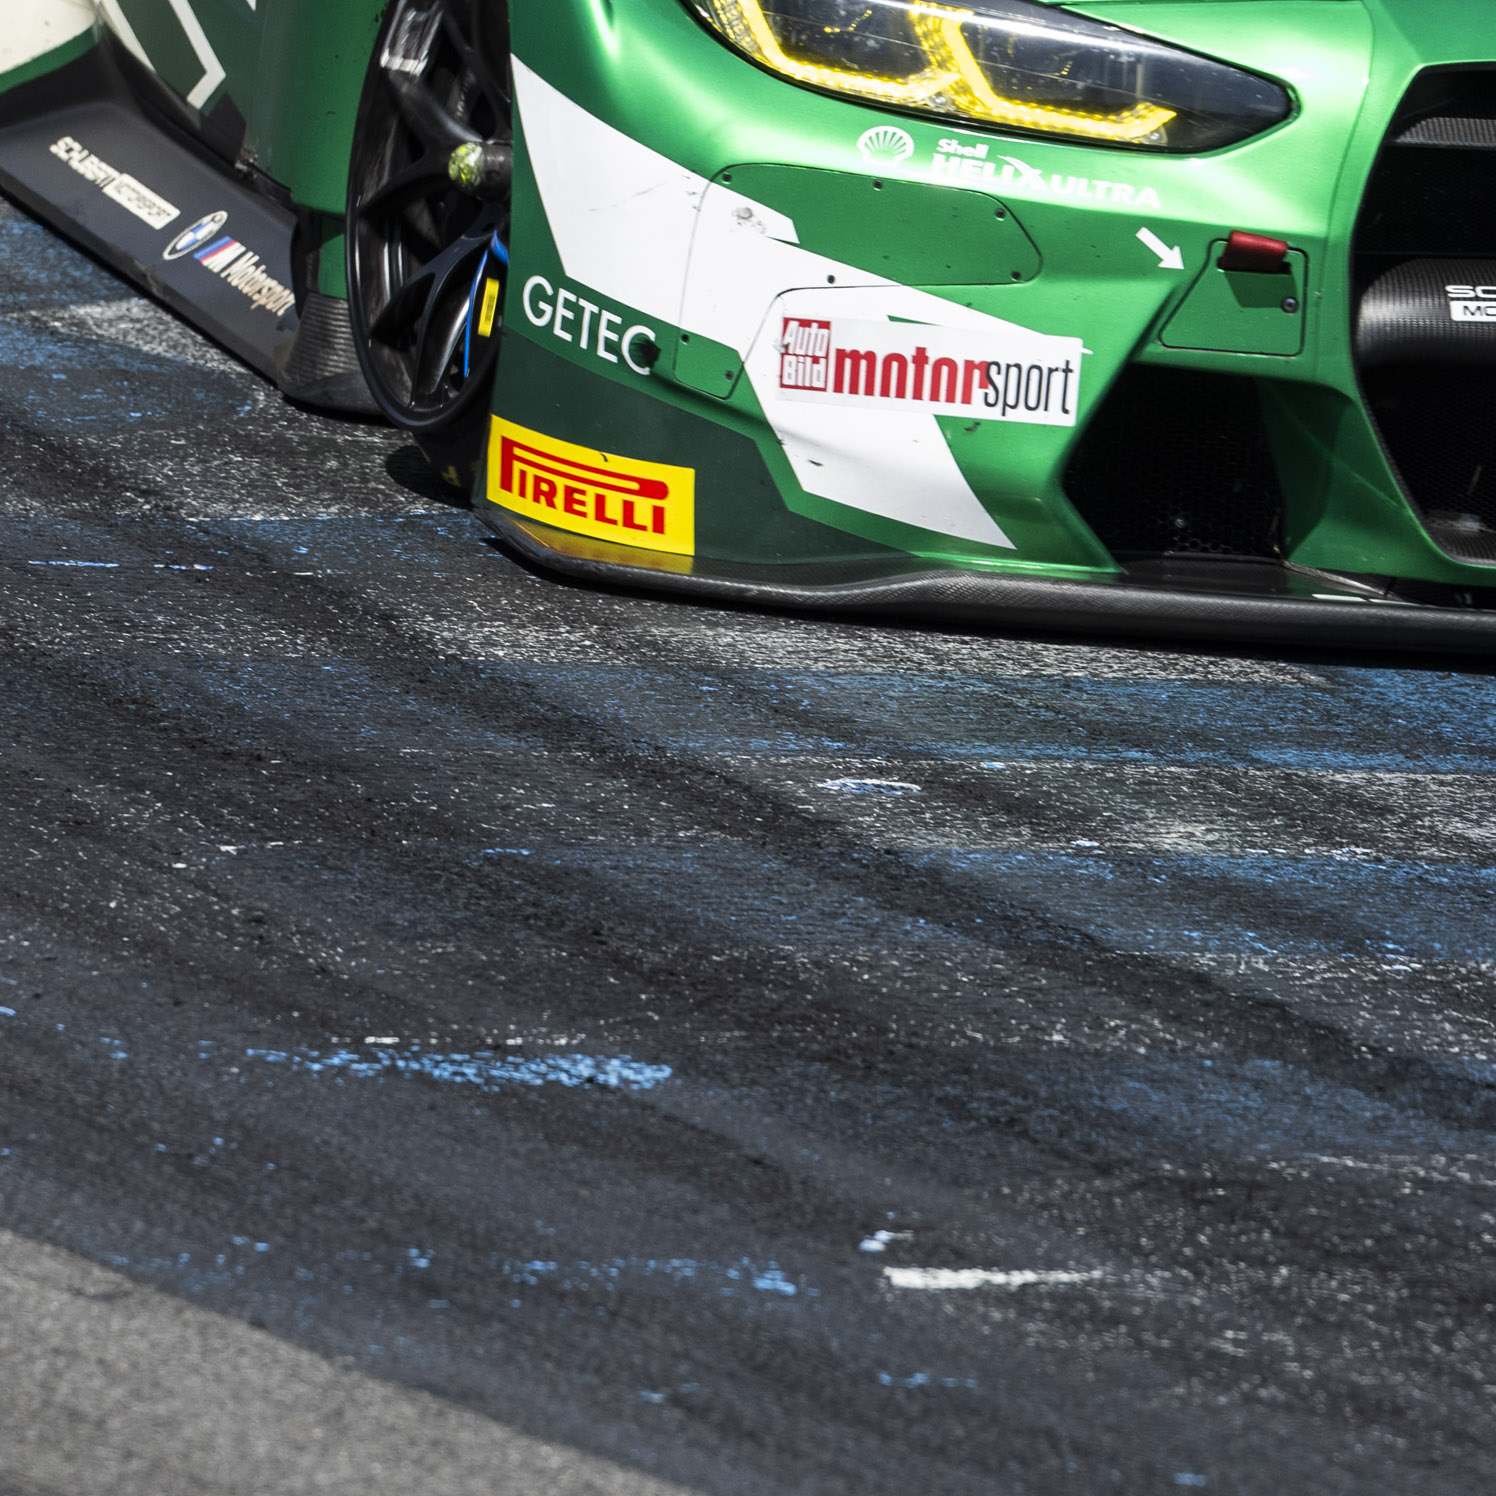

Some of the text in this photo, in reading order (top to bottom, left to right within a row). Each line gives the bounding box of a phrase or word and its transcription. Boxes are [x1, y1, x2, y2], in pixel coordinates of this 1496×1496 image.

[936, 138, 989, 159] Shell
[1049, 174, 1163, 210] ULTRA
[522, 274, 658, 376] GETEC
[834, 346, 1074, 417] motorsport
[500, 435, 669, 535] PIRELLI
